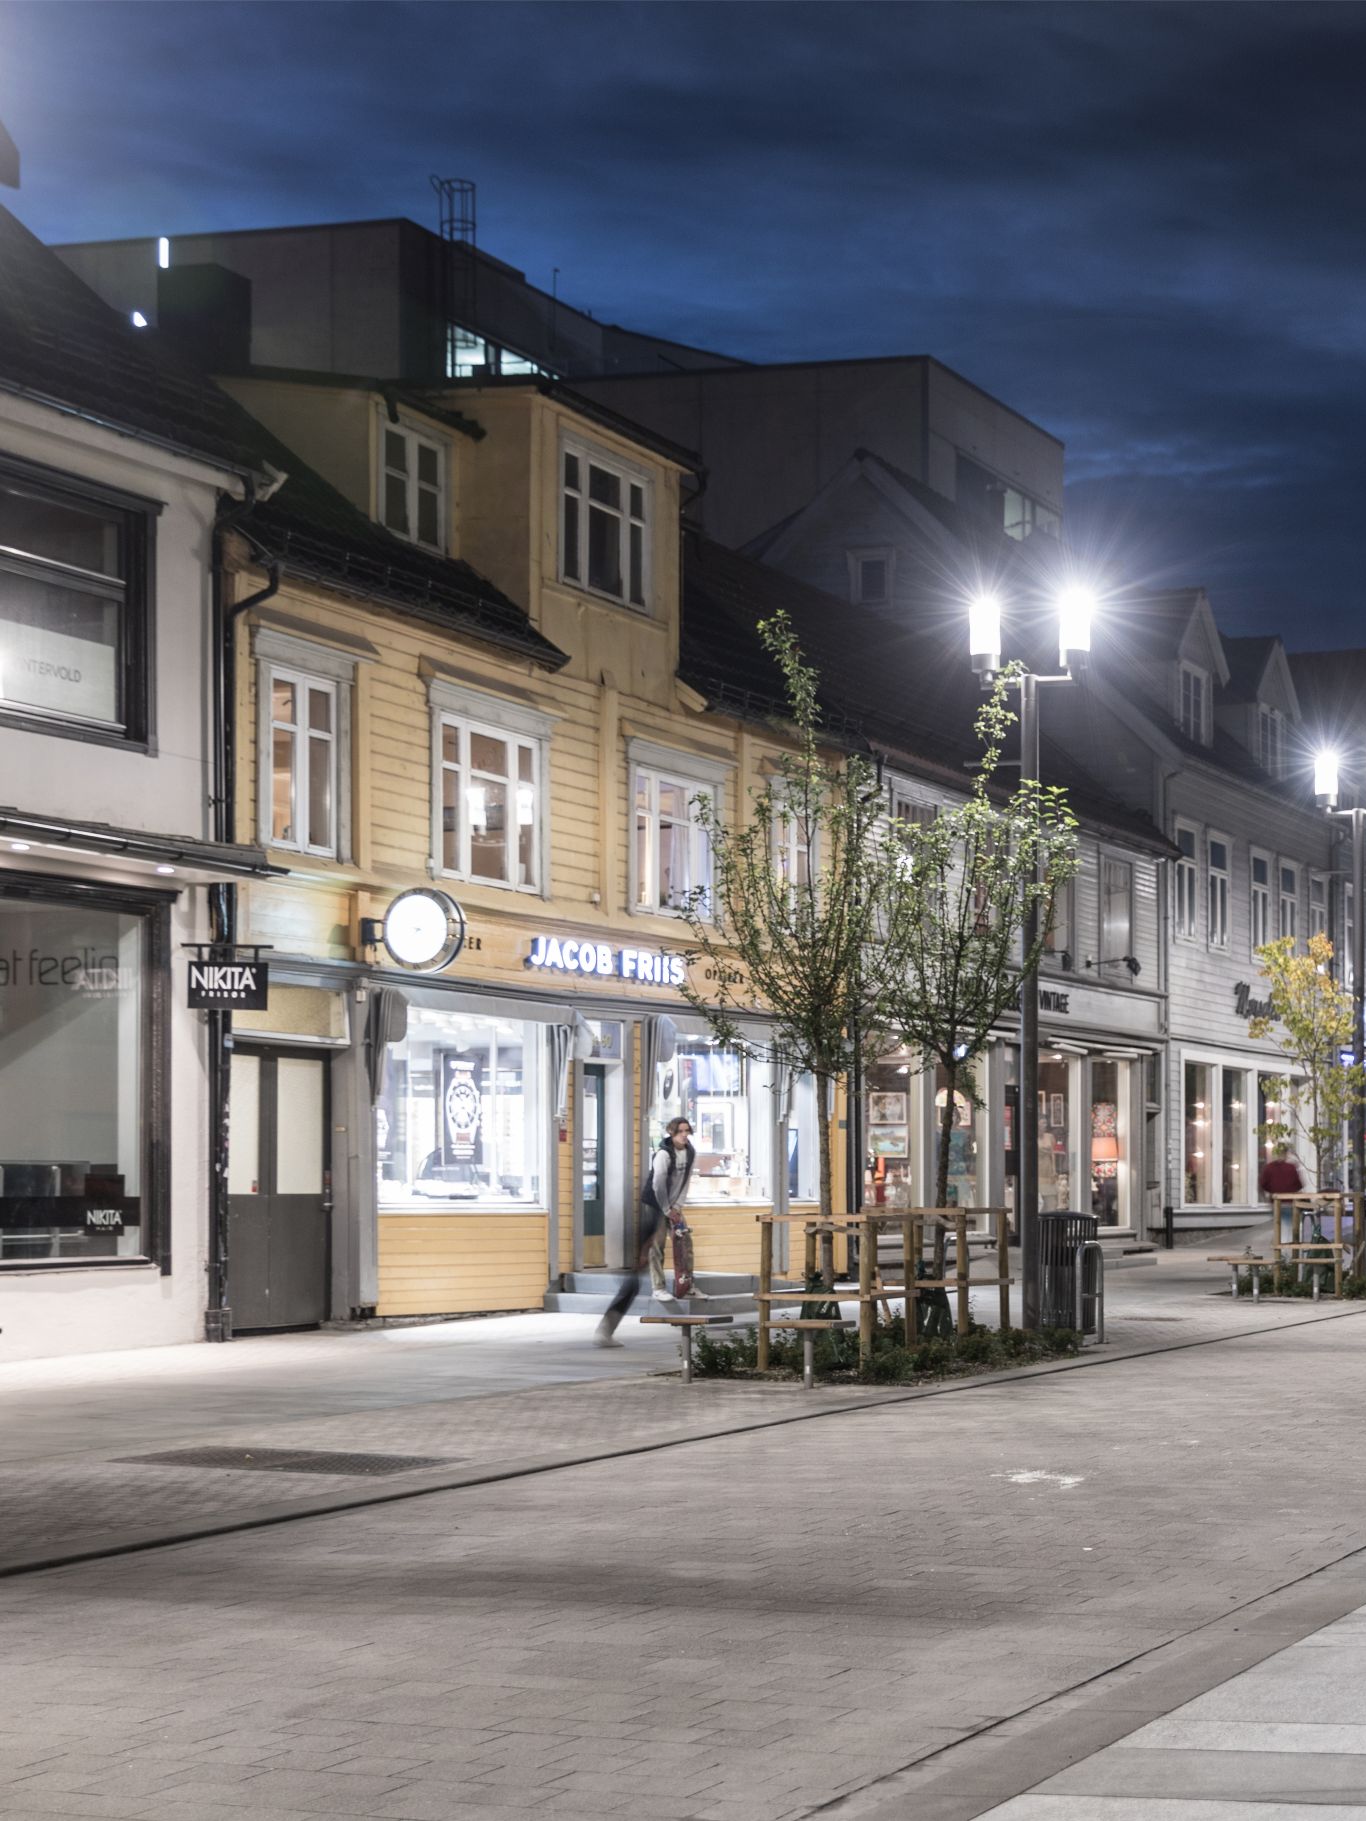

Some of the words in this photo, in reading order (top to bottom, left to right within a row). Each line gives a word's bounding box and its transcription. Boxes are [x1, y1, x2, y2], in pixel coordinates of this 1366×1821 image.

[529, 935, 613, 975] JACOB
[620, 948, 685, 985] FRIIS
[191, 965, 257, 990] NIKITA
[1038, 989, 1070, 1014] VINTAGE
[86, 1209, 123, 1225] NIKITA
